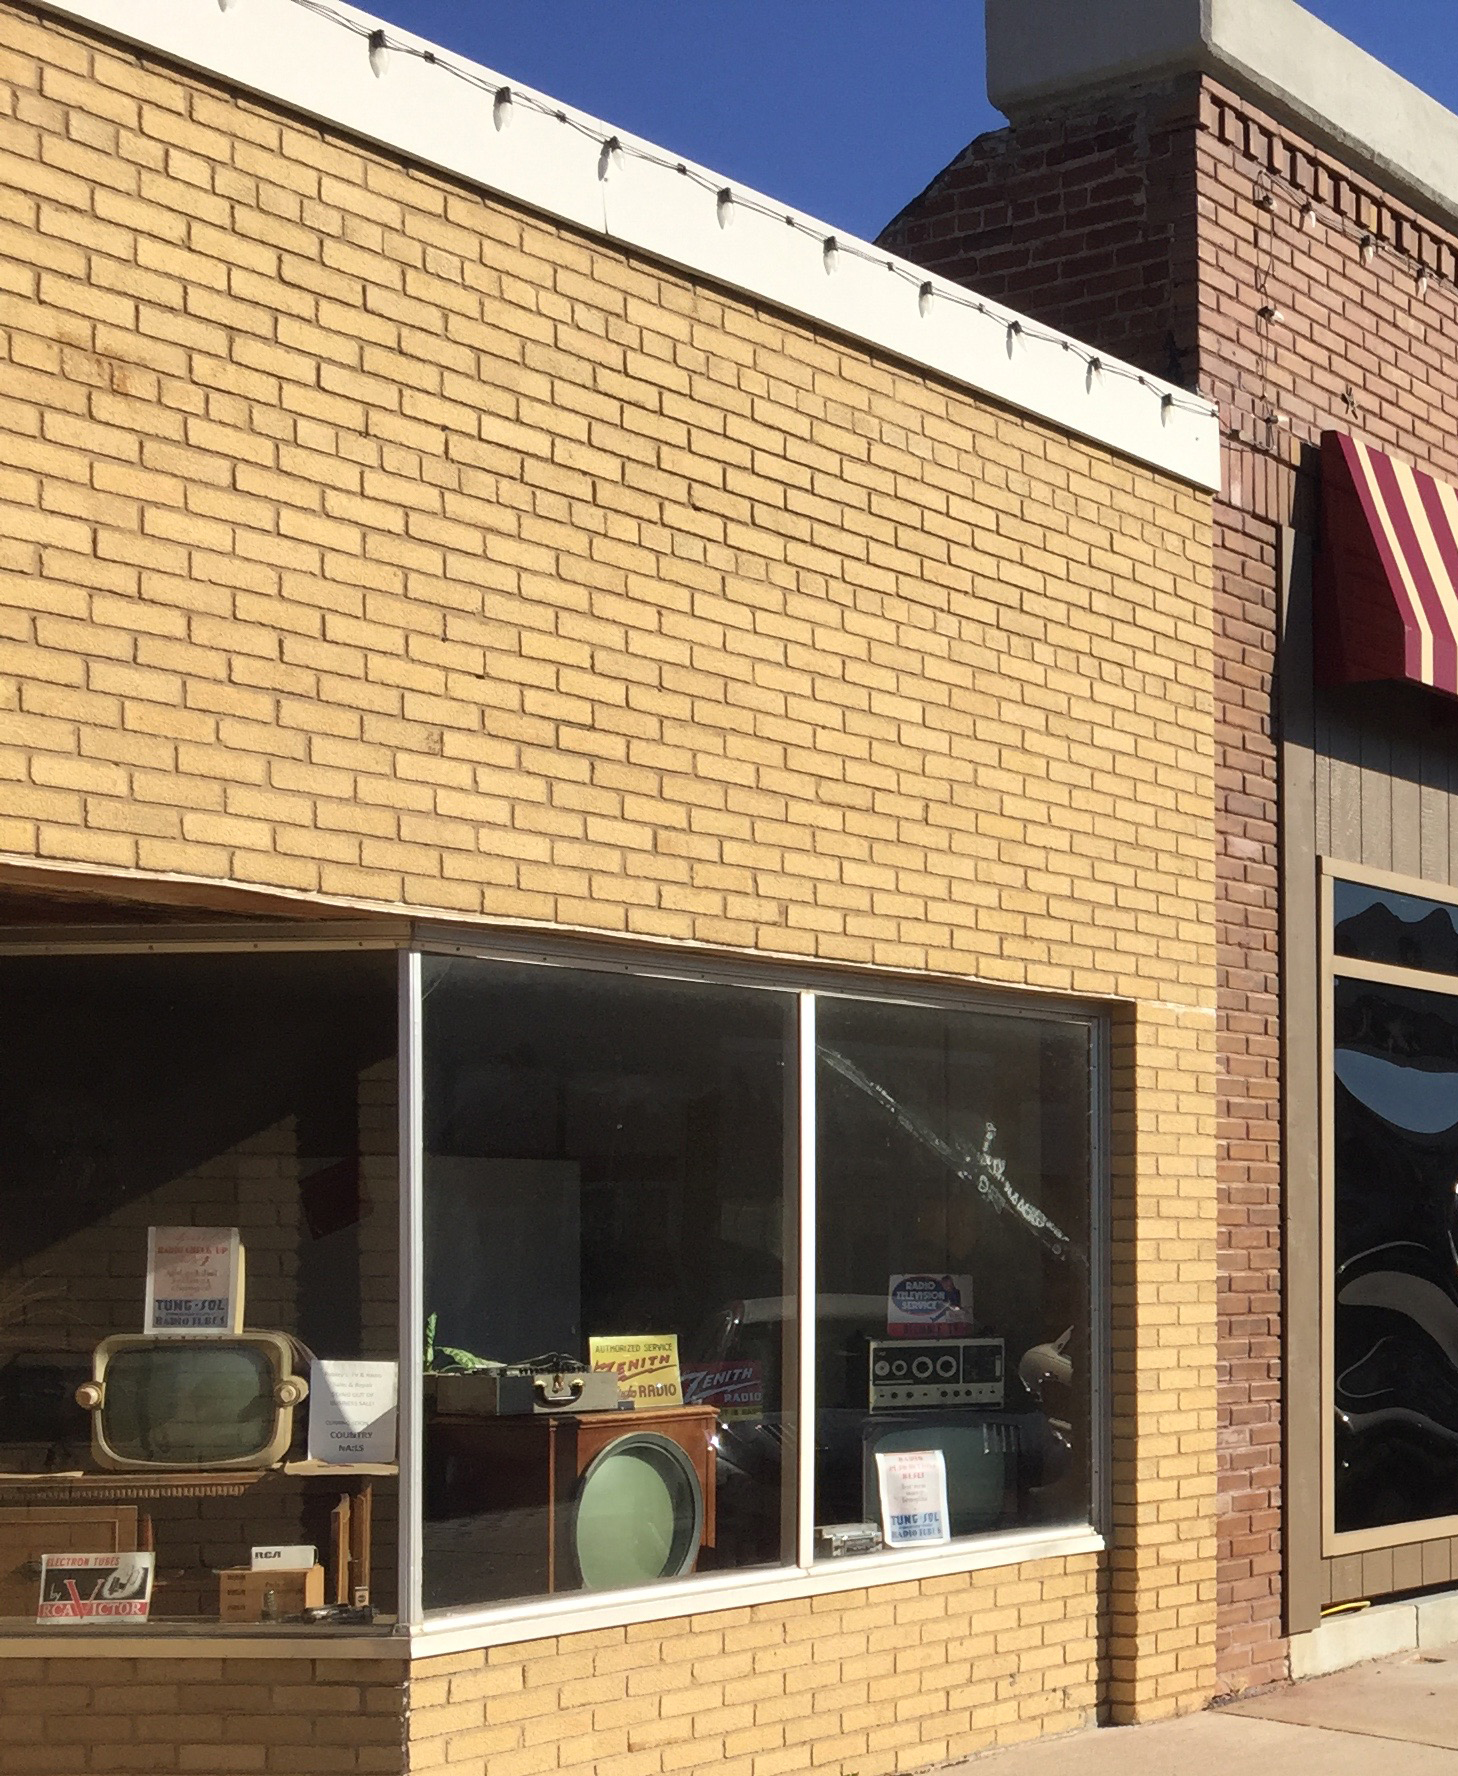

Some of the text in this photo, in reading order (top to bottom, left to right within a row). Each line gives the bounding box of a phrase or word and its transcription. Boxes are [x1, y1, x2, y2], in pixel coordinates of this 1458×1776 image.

[905, 1281, 936, 1291] RADIO
[896, 1291, 946, 1300] TELEVISION
[901, 1300, 937, 1310] SERVICE
[596, 1343, 673, 1353] AUTHORIZED SERVICE
[638, 1383, 677, 1398] RADIO
[680, 1368, 753, 1403] ZENITH
[723, 1392, 762, 1403] RADIO
[330, 1431, 373, 1439] COUNTRY
[338, 1444, 365, 1452] NAILS
[254, 1551, 282, 1559] RCA
[47, 1556, 121, 1567] ELECTRON TUBES
[49, 1582, 62, 1602] by
[42, 1603, 74, 1617] RCA
